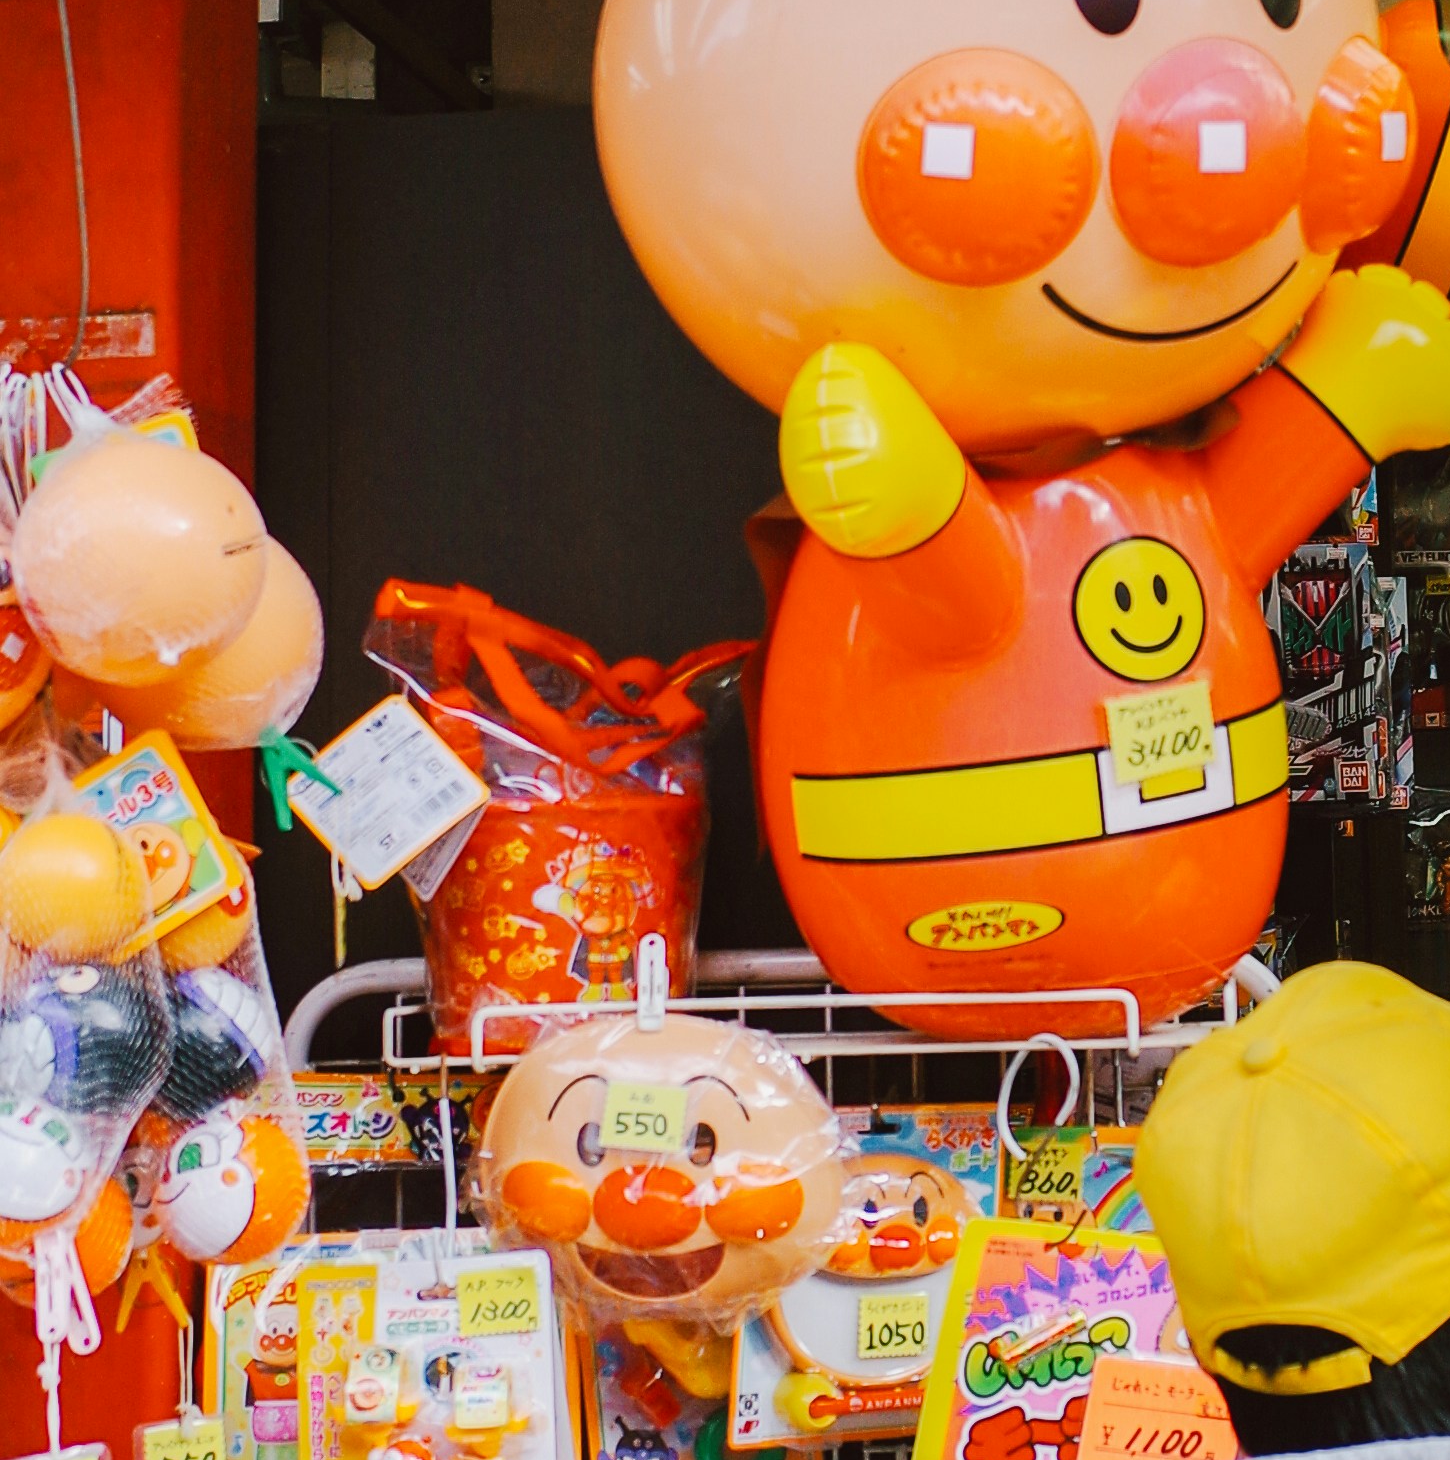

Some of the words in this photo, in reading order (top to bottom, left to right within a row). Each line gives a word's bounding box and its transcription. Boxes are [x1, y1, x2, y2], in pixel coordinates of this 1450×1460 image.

[1342, 766, 1366, 778] BAN
[1342, 777, 1364, 788] DAI
[615, 1113, 667, 1136] 550
[926, 1128, 995, 1151] らくがき
[865, 1320, 925, 1351] 1050
